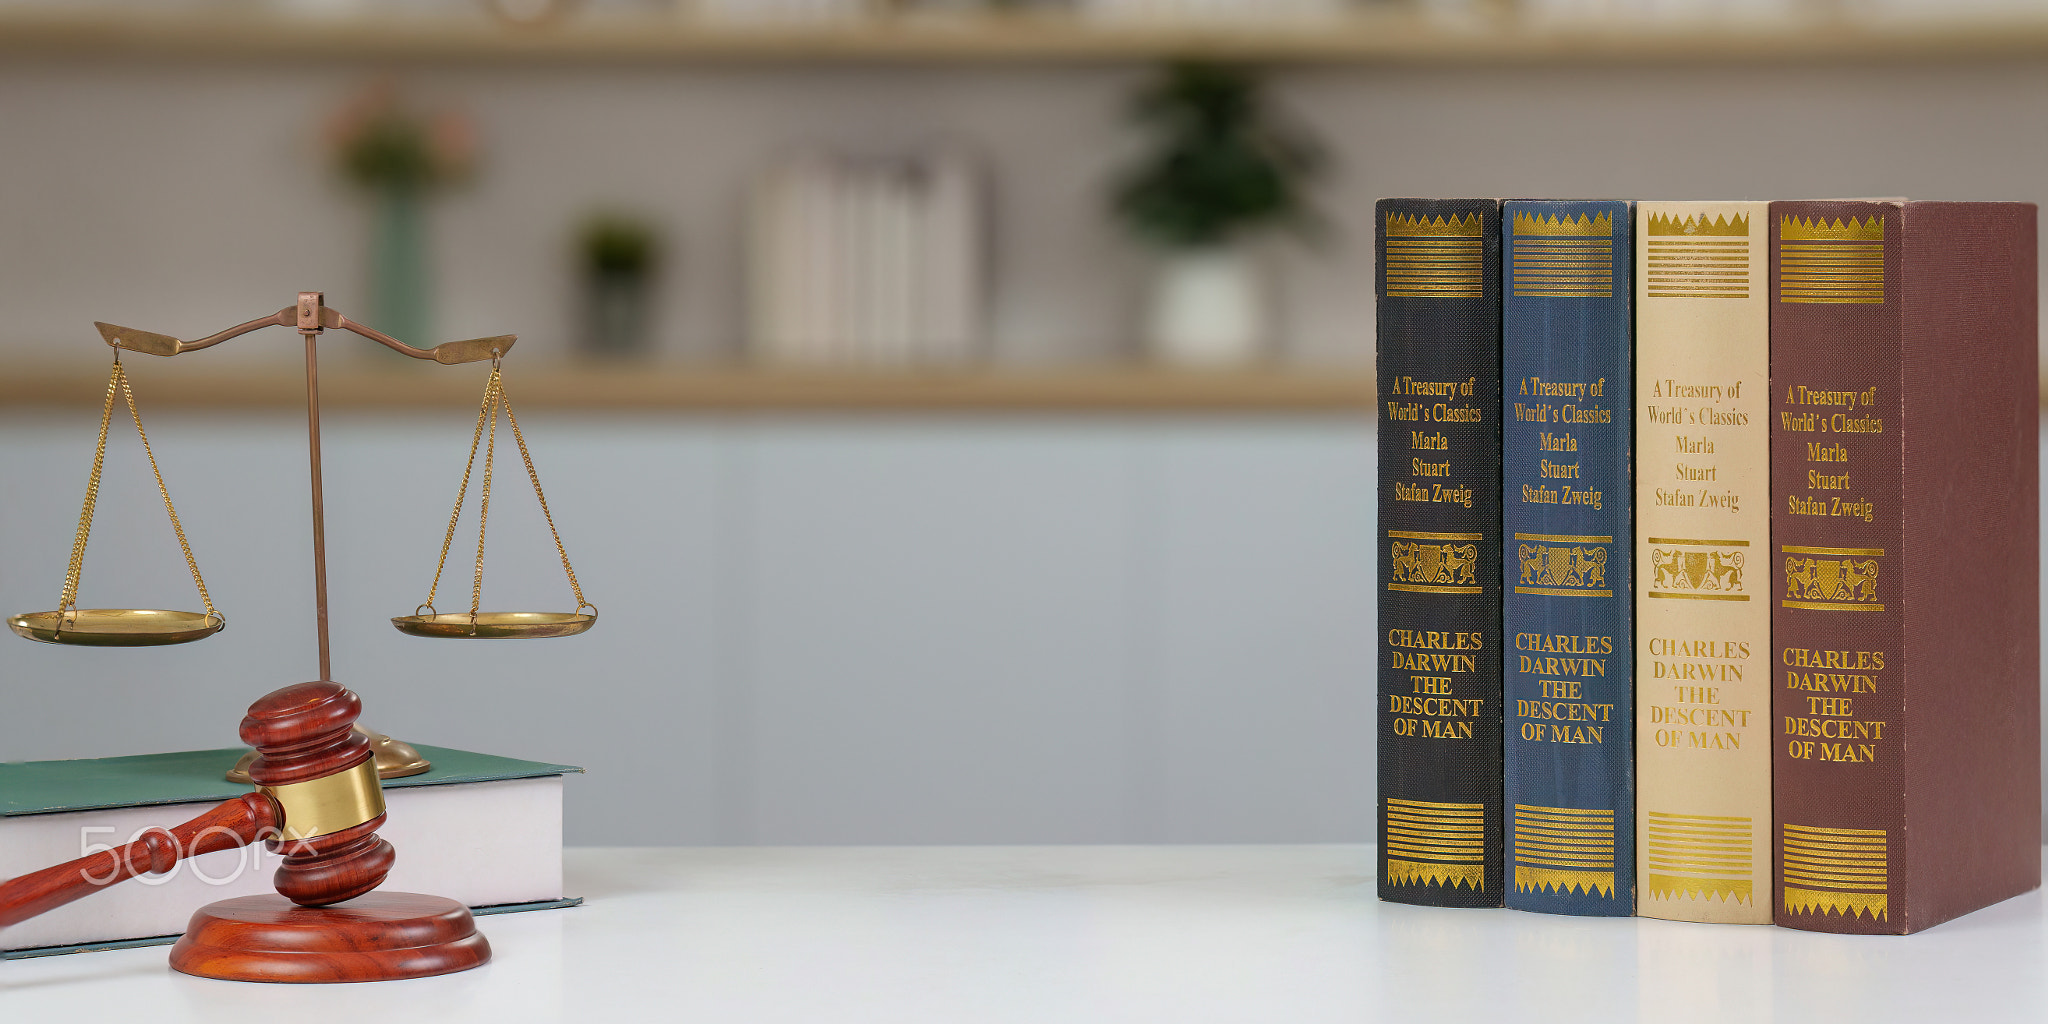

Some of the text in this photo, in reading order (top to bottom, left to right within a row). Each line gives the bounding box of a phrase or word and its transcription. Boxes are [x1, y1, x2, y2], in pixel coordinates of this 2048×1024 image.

[1392, 376, 1475, 400] A Treasury of
[1519, 377, 1605, 401] A Treasury of
[1653, 380, 1742, 403] A Treasury of
[1786, 385, 1876, 410] A Treasury of
[1433, 403, 1481, 423] Classics
[1562, 404, 1611, 423] Classics
[1699, 408, 1749, 426] Classics
[1831, 414, 1883, 433] Classics
[1412, 431, 1448, 450] Marla
[1540, 432, 1577, 451] Marla
[1676, 436, 1715, 454] Marla
[1807, 442, 1847, 462] Marla
[1412, 457, 1451, 477] Stuart
[1540, 459, 1579, 478] Stuart
[1676, 463, 1717, 481] Stuart
[1808, 470, 1850, 489] Stuart
[1395, 482, 1472, 508] Stafan Zweig
[1522, 484, 1602, 510] Stafan Zweig
[1656, 488, 1739, 513] Stafan Zweig
[1789, 495, 1873, 522] Stafan Zweig
[1389, 629, 1483, 650] CHARLES
[1515, 633, 1613, 654] CHARLES
[1649, 638, 1750, 659] CHARLES
[1392, 652, 1476, 673] DARWIN
[1519, 655, 1606, 677] DARWIN
[1783, 647, 1885, 670] CHARLES
[1653, 662, 1743, 682] DARWIN
[1787, 671, 1878, 693] DARWIN
[1411, 676, 1452, 695] THE
[1539, 680, 1582, 699] THE
[1674, 686, 1720, 704] THE
[1390, 695, 1483, 717] DESCENT
[1517, 700, 1613, 722] DESCENT
[1650, 706, 1751, 727] DESCENT
[1807, 697, 1853, 717] THE
[1394, 718, 1473, 739] OF MAN
[1521, 723, 1604, 744] OF MAN
[1785, 716, 1886, 739] DESCENT
[1655, 729, 1741, 750] OF MAN
[1788, 740, 1876, 762] OF MAN
